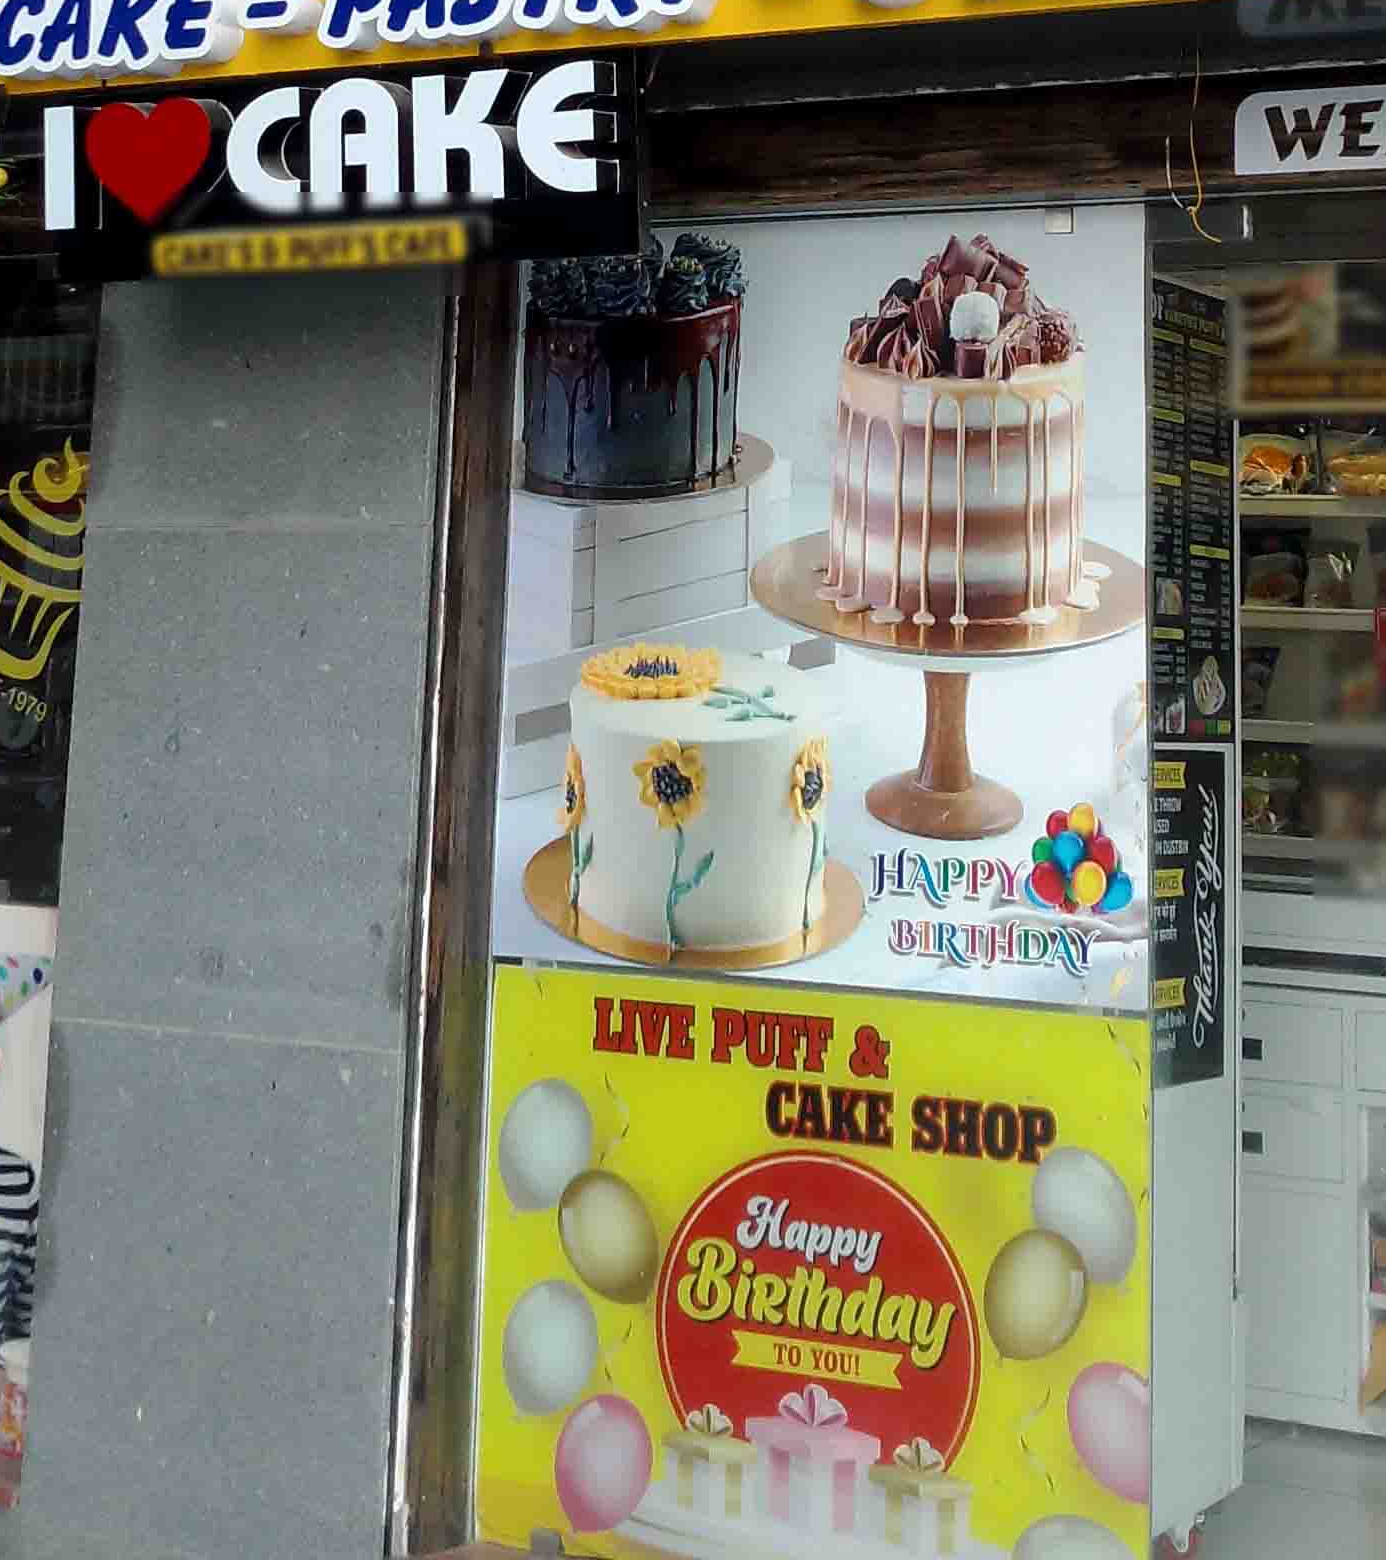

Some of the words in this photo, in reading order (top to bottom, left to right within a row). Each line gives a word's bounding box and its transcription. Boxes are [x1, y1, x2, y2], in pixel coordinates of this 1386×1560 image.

[44, 105, 76, 231] I
[226, 60, 599, 215] CAKE
[869, 847, 1027, 907] HAPPY
[888, 920, 1101, 977] BIRTHDAY
[1193, 902, 1218, 1048] Thank
[592, 997, 696, 1060] LIVE
[710, 1007, 835, 1073] PUFF
[849, 1024, 891, 1079] &
[765, 1080, 895, 1148] CAKE
[911, 1095, 1057, 1165] SHOP
[735, 1195, 882, 1273] Happy
[676, 1237, 957, 1369] Birthday
[773, 1343, 802, 1367] TO
[811, 1348, 861, 1377] YOU!
